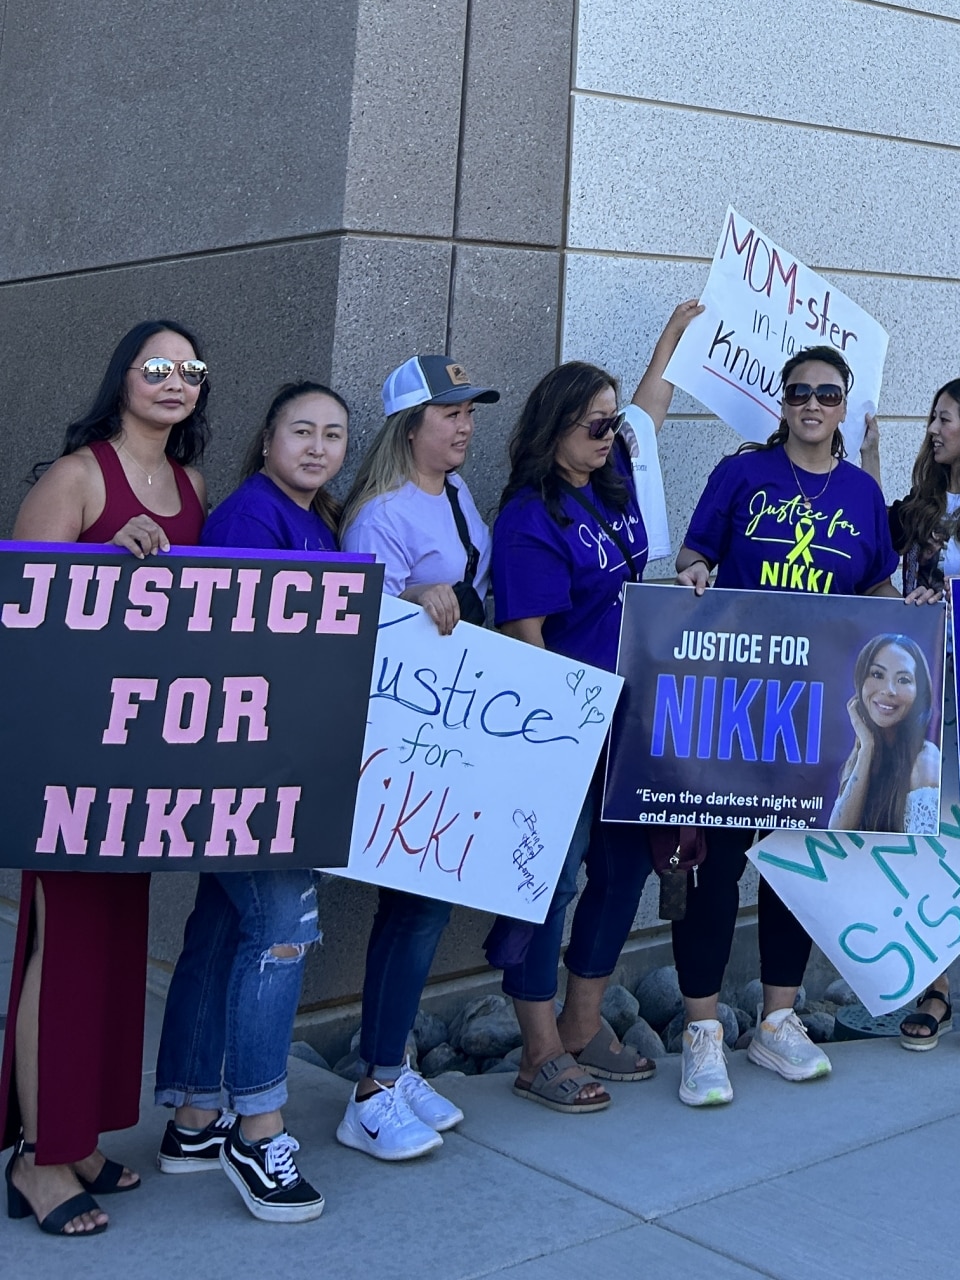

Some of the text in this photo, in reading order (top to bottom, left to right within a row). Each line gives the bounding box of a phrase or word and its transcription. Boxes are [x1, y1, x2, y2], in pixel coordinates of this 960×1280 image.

[745, 491, 860, 538] Justice for
[1, 563, 366, 635] JUSTICE
[760, 561, 833, 595] NIKKI
[370, 611, 579, 745] ustice
[673, 630, 810, 667] JUSTICE FOR
[101, 676, 270, 744] FOR
[650, 673, 824, 765] NIKKI
[35, 785, 302, 857] NIKKI
[360, 748, 481, 882] ikki
[636, 789, 823, 811] “Even the darkest night will
[639, 810, 667, 824] end
[669, 811, 696, 824] and
[699, 812, 723, 825] the
[726, 816, 750, 827] sun
[754, 815, 777, 828] will
